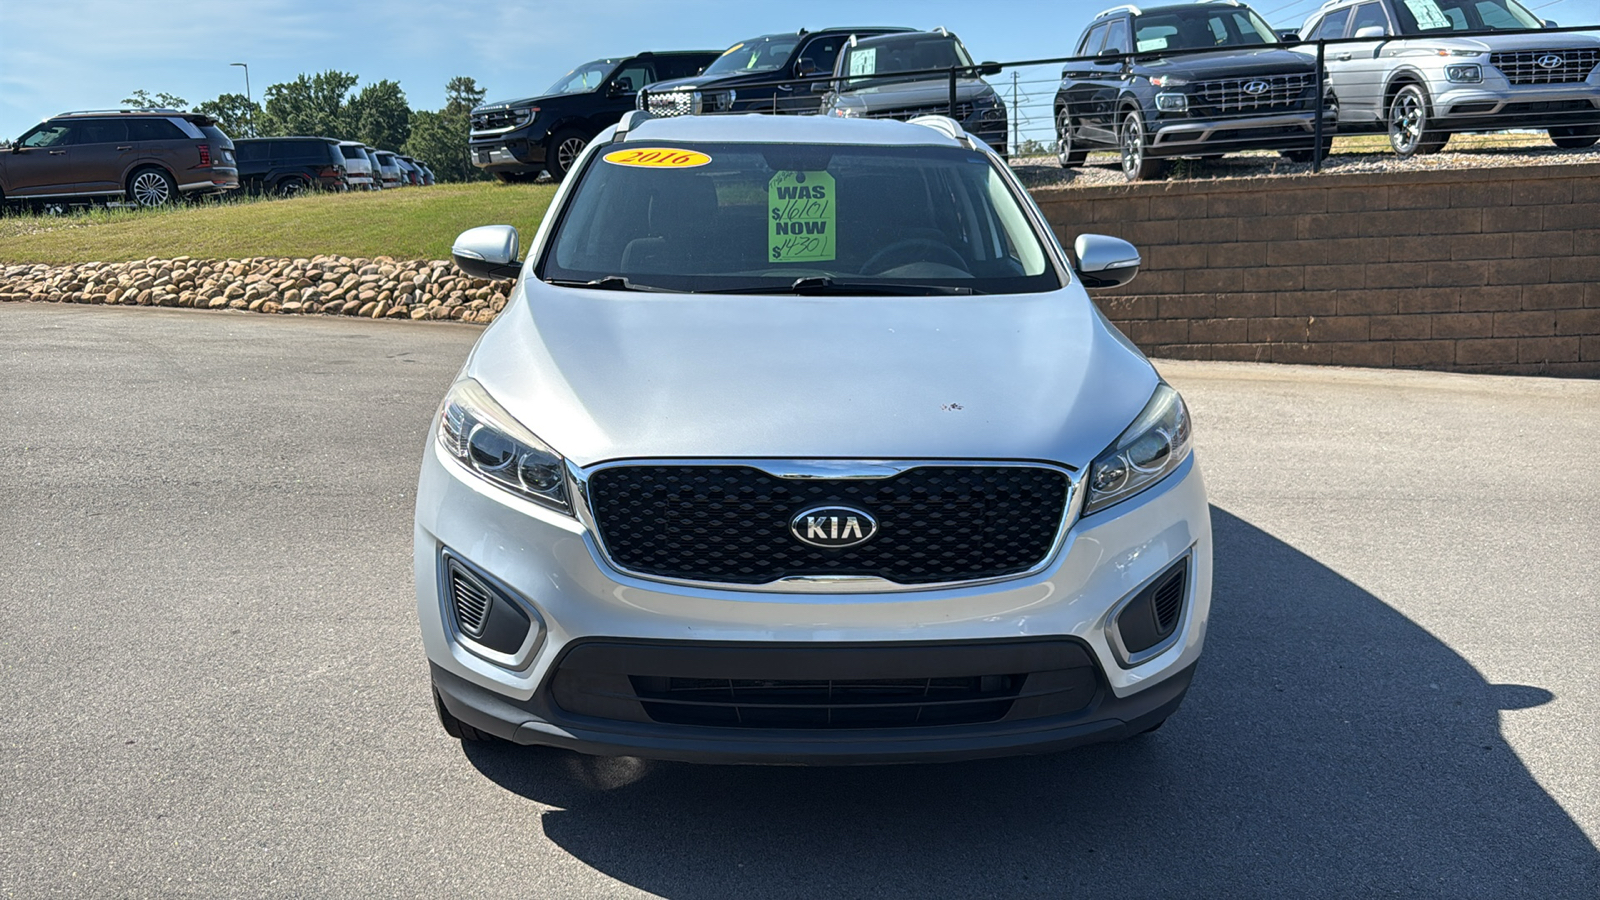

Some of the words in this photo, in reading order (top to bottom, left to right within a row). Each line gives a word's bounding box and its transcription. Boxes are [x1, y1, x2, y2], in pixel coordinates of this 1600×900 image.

[618, 151, 697, 164] 2016
[776, 186, 826, 200] WAS
[775, 221, 827, 235] NOW
[807, 516, 863, 539] KIA
